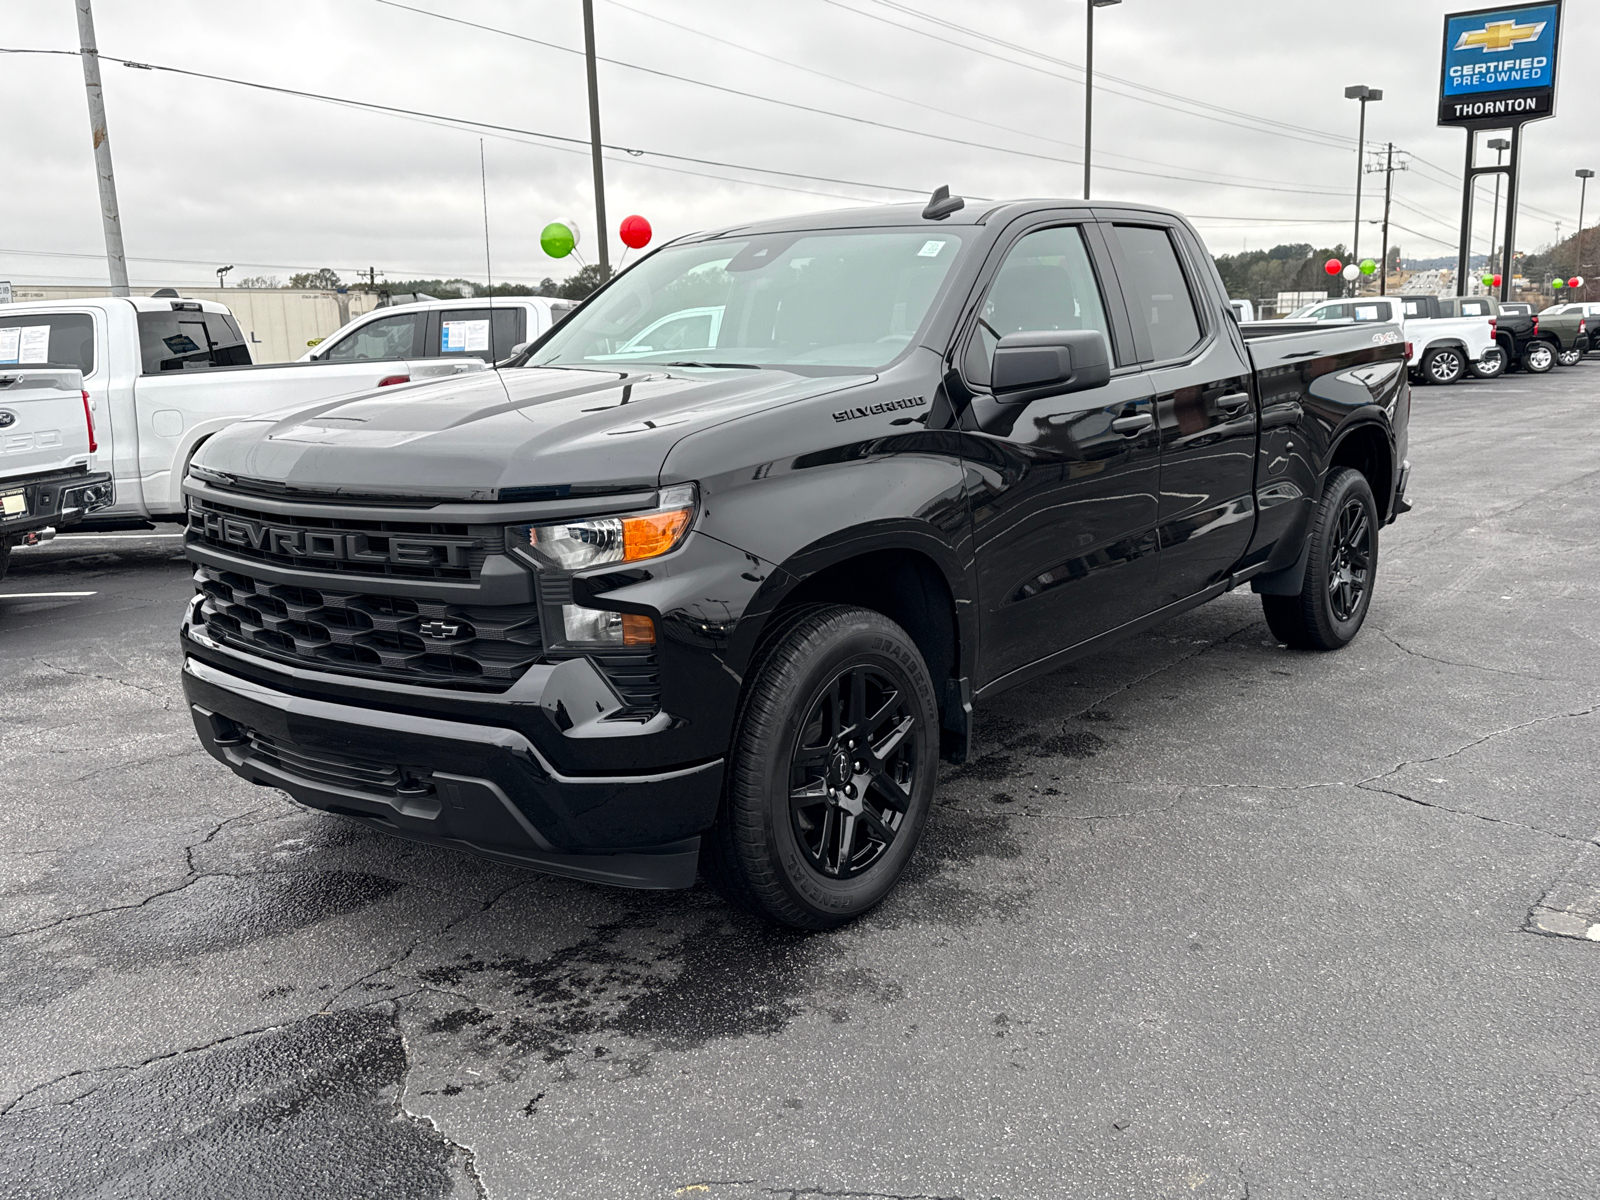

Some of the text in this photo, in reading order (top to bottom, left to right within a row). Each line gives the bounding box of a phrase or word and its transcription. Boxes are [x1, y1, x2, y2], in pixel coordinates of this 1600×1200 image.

[1449, 56, 1547, 77] CERTIFIED
[1453, 68, 1541, 87] PRE-OWNED
[1454, 97, 1536, 117] THORNTON
[832, 395, 927, 422] SILVERADO
[187, 508, 484, 567] CHEVROLET
[871, 637, 930, 699] GRABBER
[787, 853, 854, 909] GENERAL
